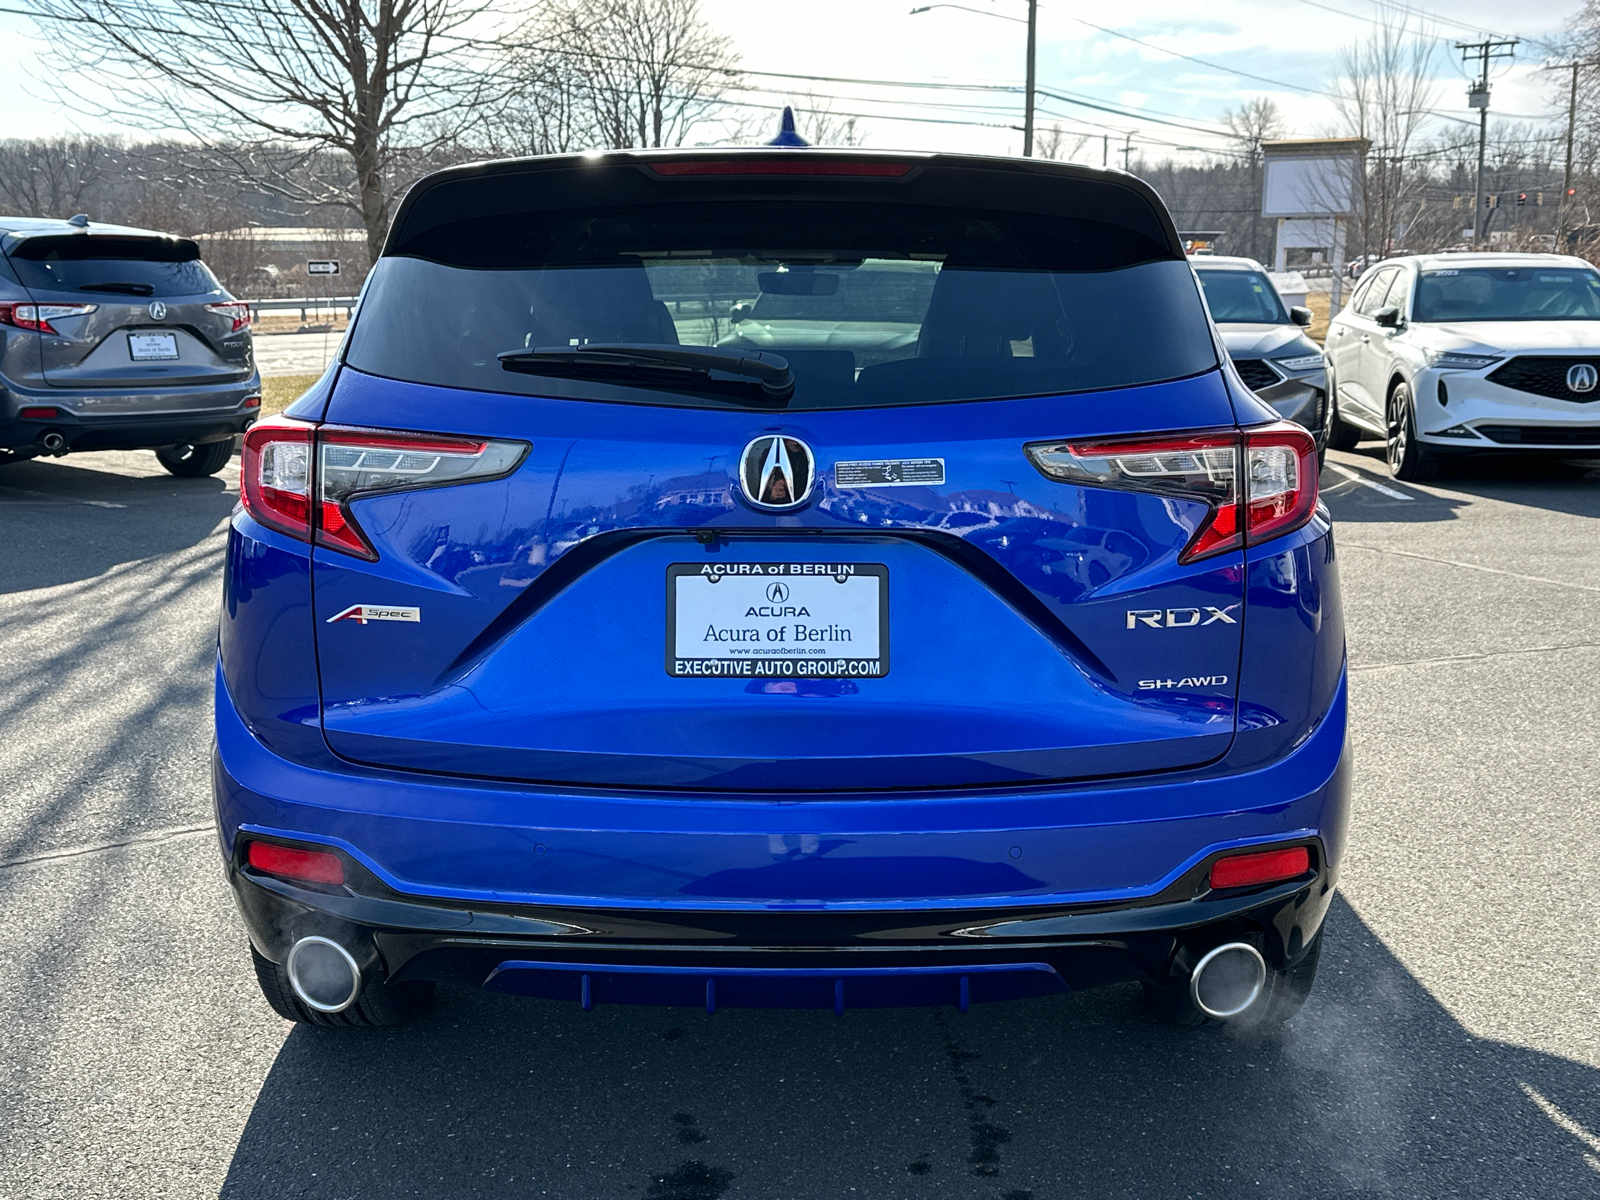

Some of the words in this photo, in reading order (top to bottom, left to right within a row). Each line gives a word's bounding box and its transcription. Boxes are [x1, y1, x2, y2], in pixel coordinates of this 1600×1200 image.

[700, 564, 763, 574] ACURA
[768, 564, 785, 574] of
[790, 564, 854, 574] BERLIN
[745, 606, 811, 617] ACURA
[1126, 602, 1242, 630] RDX
[703, 624, 760, 642] Acura
[766, 624, 787, 642] of
[794, 624, 852, 642] Berlin
[729, 647, 826, 655] www.acuraofberlin.com
[675, 661, 751, 675] EXECUTIVE
[755, 661, 793, 675] AUTO
[796, 661, 880, 675] GROUP.COM
[1138, 675, 1228, 690] SH-AWD
